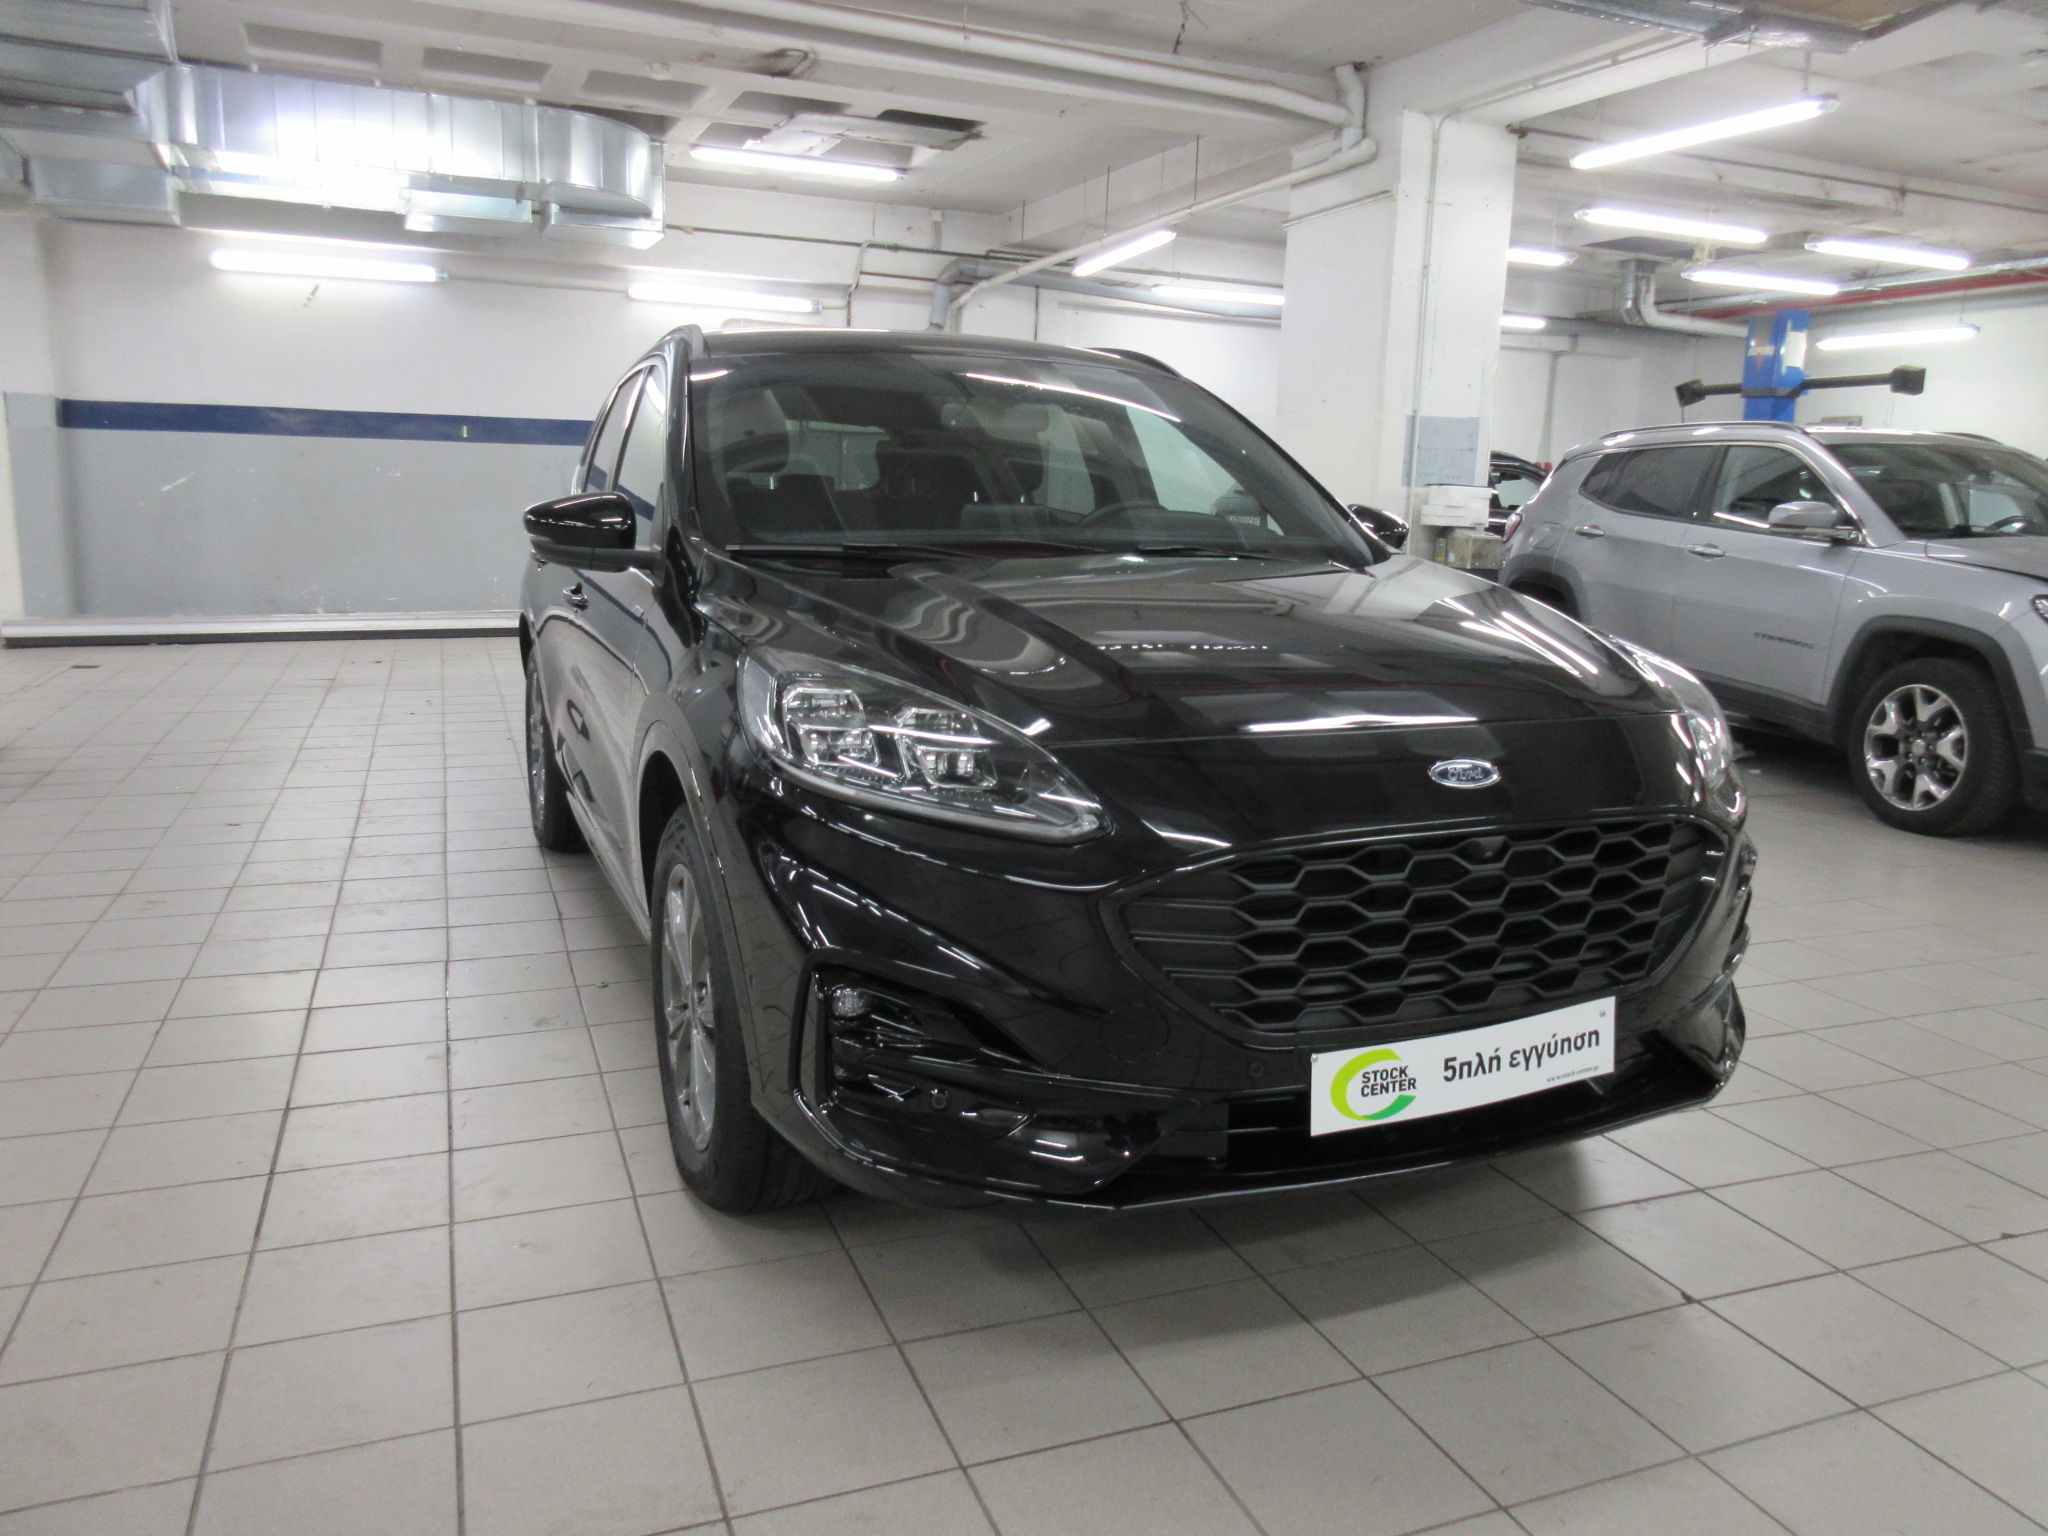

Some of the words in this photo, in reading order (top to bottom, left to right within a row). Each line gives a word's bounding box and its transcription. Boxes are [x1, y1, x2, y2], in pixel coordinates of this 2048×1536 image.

[1447, 766, 1484, 781] Ford
[1443, 1047, 1501, 1082] 5πλή
[1508, 1029, 1600, 1071] εγγύηση
[1361, 1065, 1409, 1084] STOCK
[1360, 1077, 1417, 1098] CENTER
